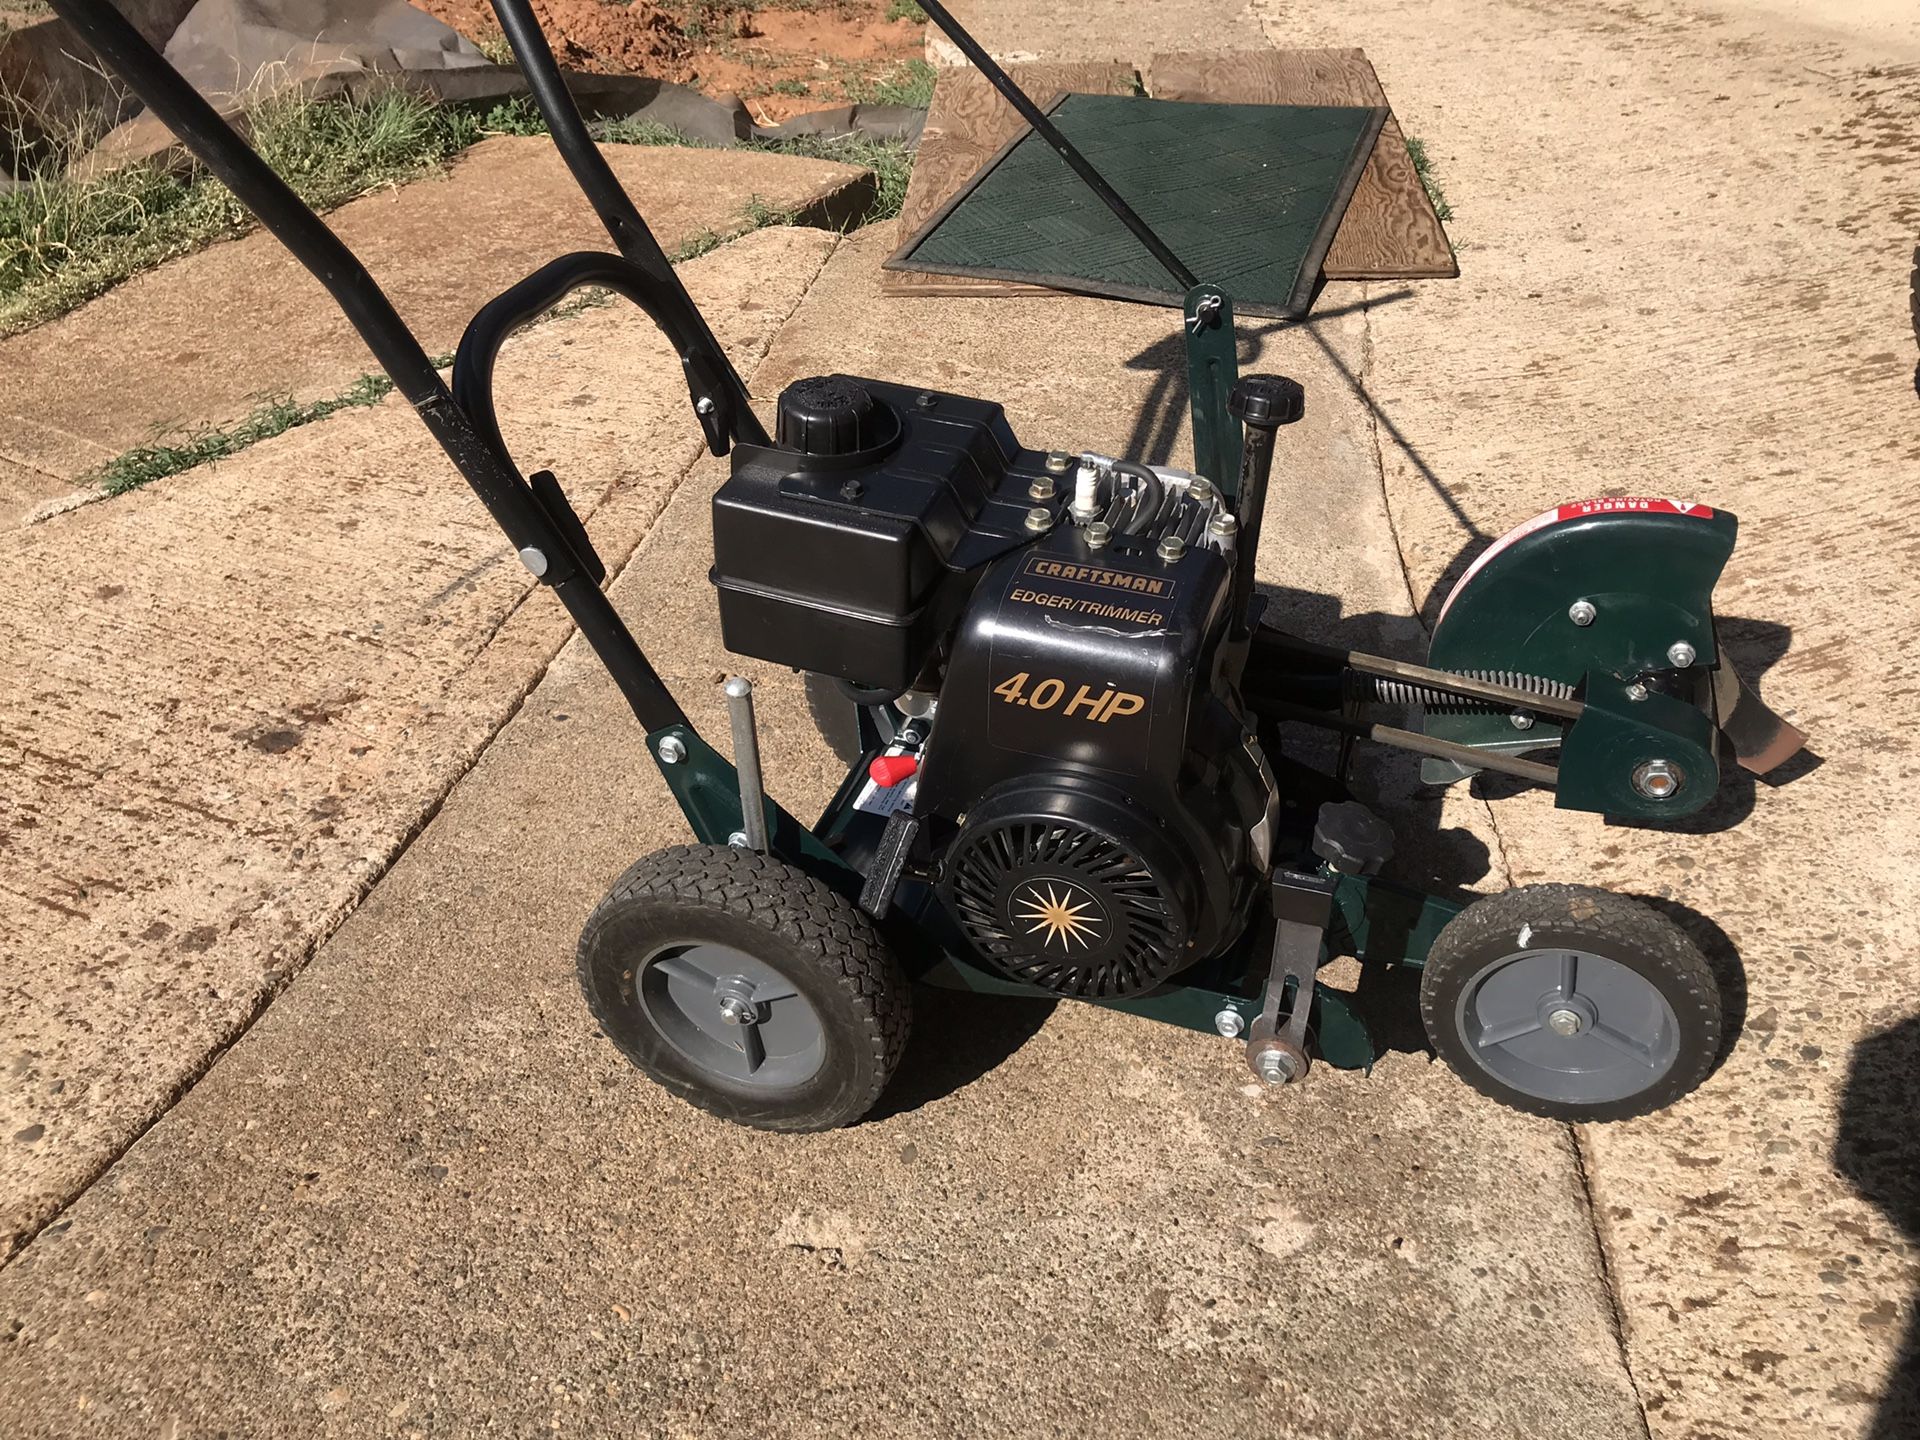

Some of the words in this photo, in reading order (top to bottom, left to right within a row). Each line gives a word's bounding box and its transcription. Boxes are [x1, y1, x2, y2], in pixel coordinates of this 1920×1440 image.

[1582, 501, 1649, 512] DANGER
[1035, 561, 1163, 594] CRAFTSMAN
[1010, 588, 1163, 626] EDGER/TRIMMER
[993, 672, 1066, 710] 4.0
[1063, 684, 1145, 723] HP
